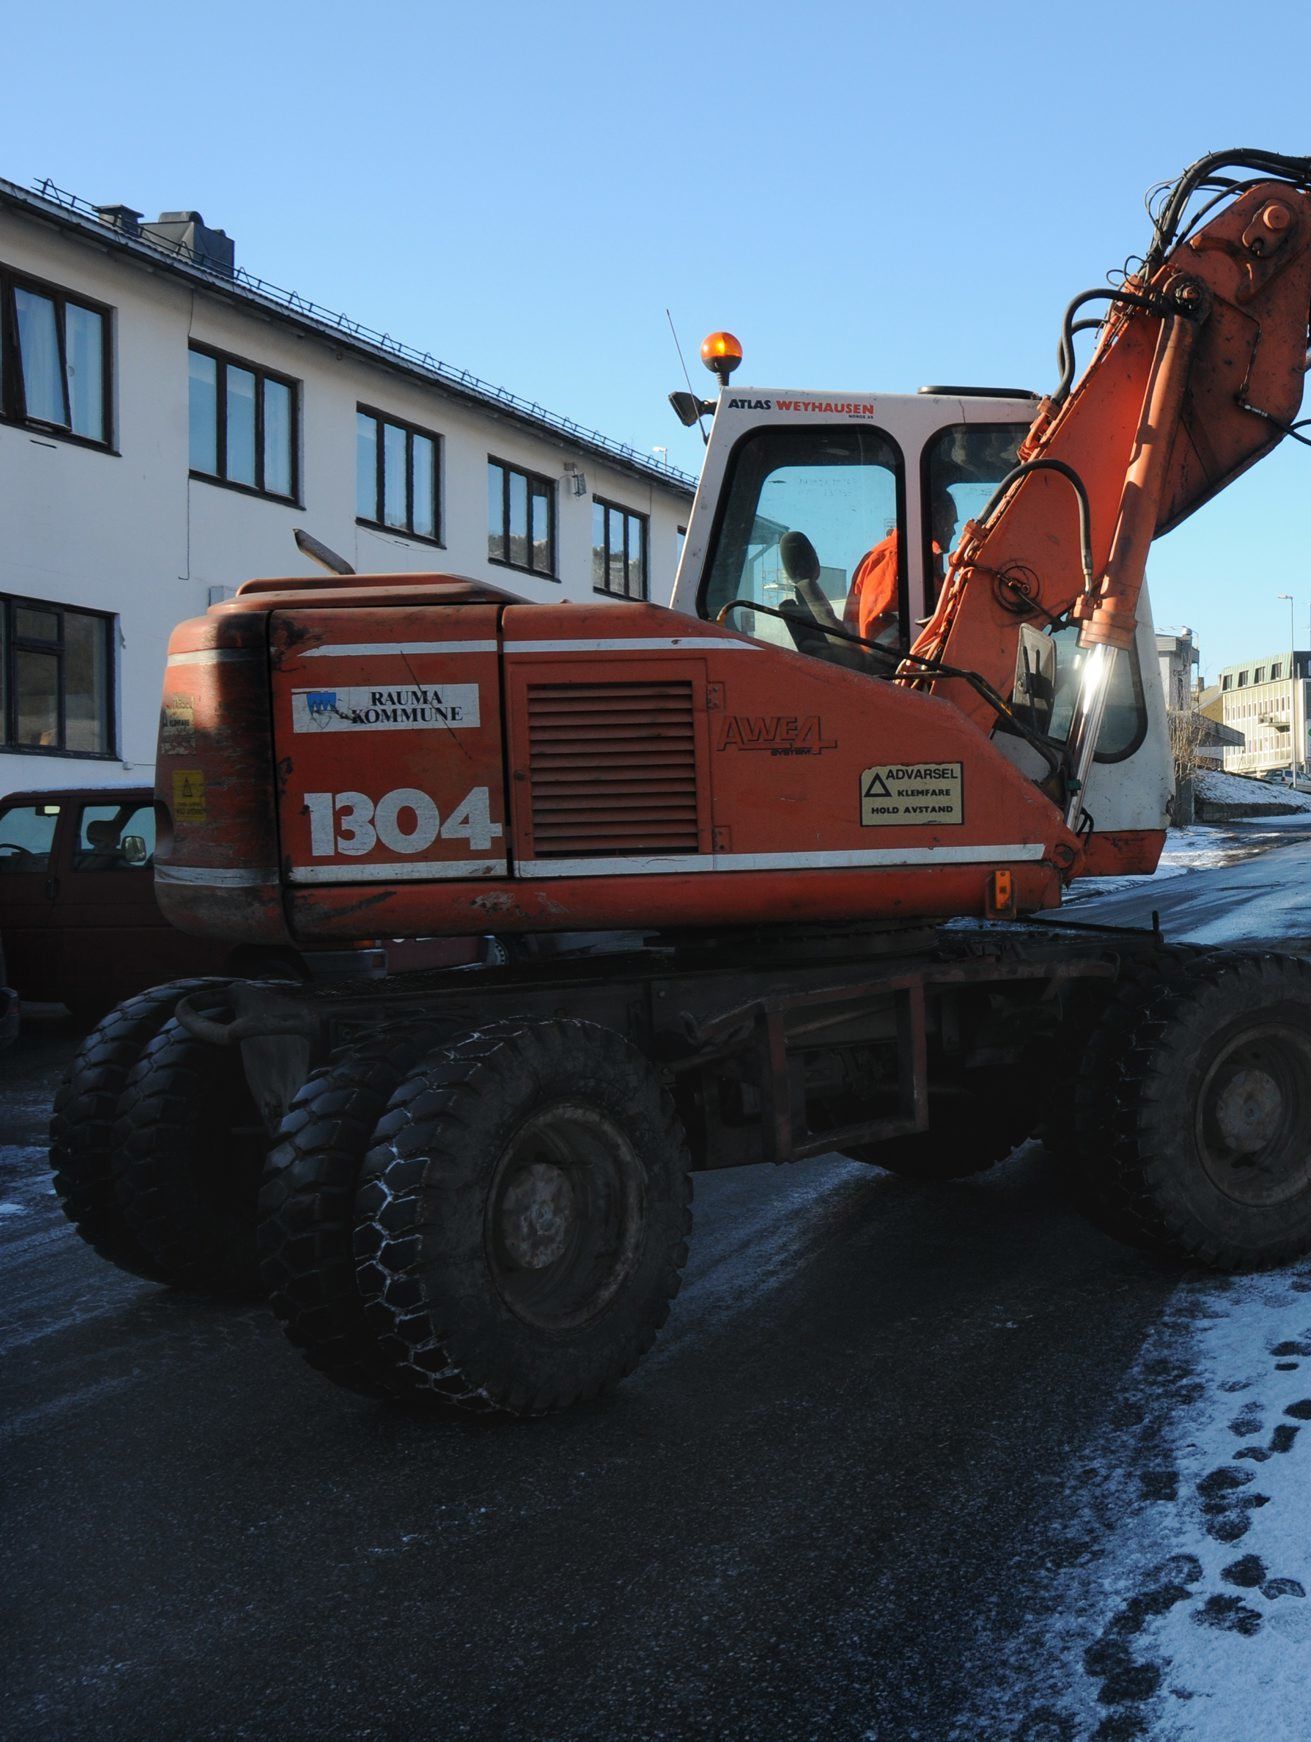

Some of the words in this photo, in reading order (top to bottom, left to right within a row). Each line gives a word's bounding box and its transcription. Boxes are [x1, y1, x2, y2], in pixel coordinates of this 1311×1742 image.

[728, 399, 771, 410] ATLAS
[776, 400, 874, 415] WEYHAUSEN
[370, 690, 443, 706] RAUMA
[351, 706, 463, 724] KOMMUNE
[885, 768, 958, 780] ADVARSEL
[897, 788, 951, 797] KLEMFARE
[871, 806, 899, 814] HOLD
[903, 805, 953, 814] AVSTAND
[304, 786, 503, 857] 1304
